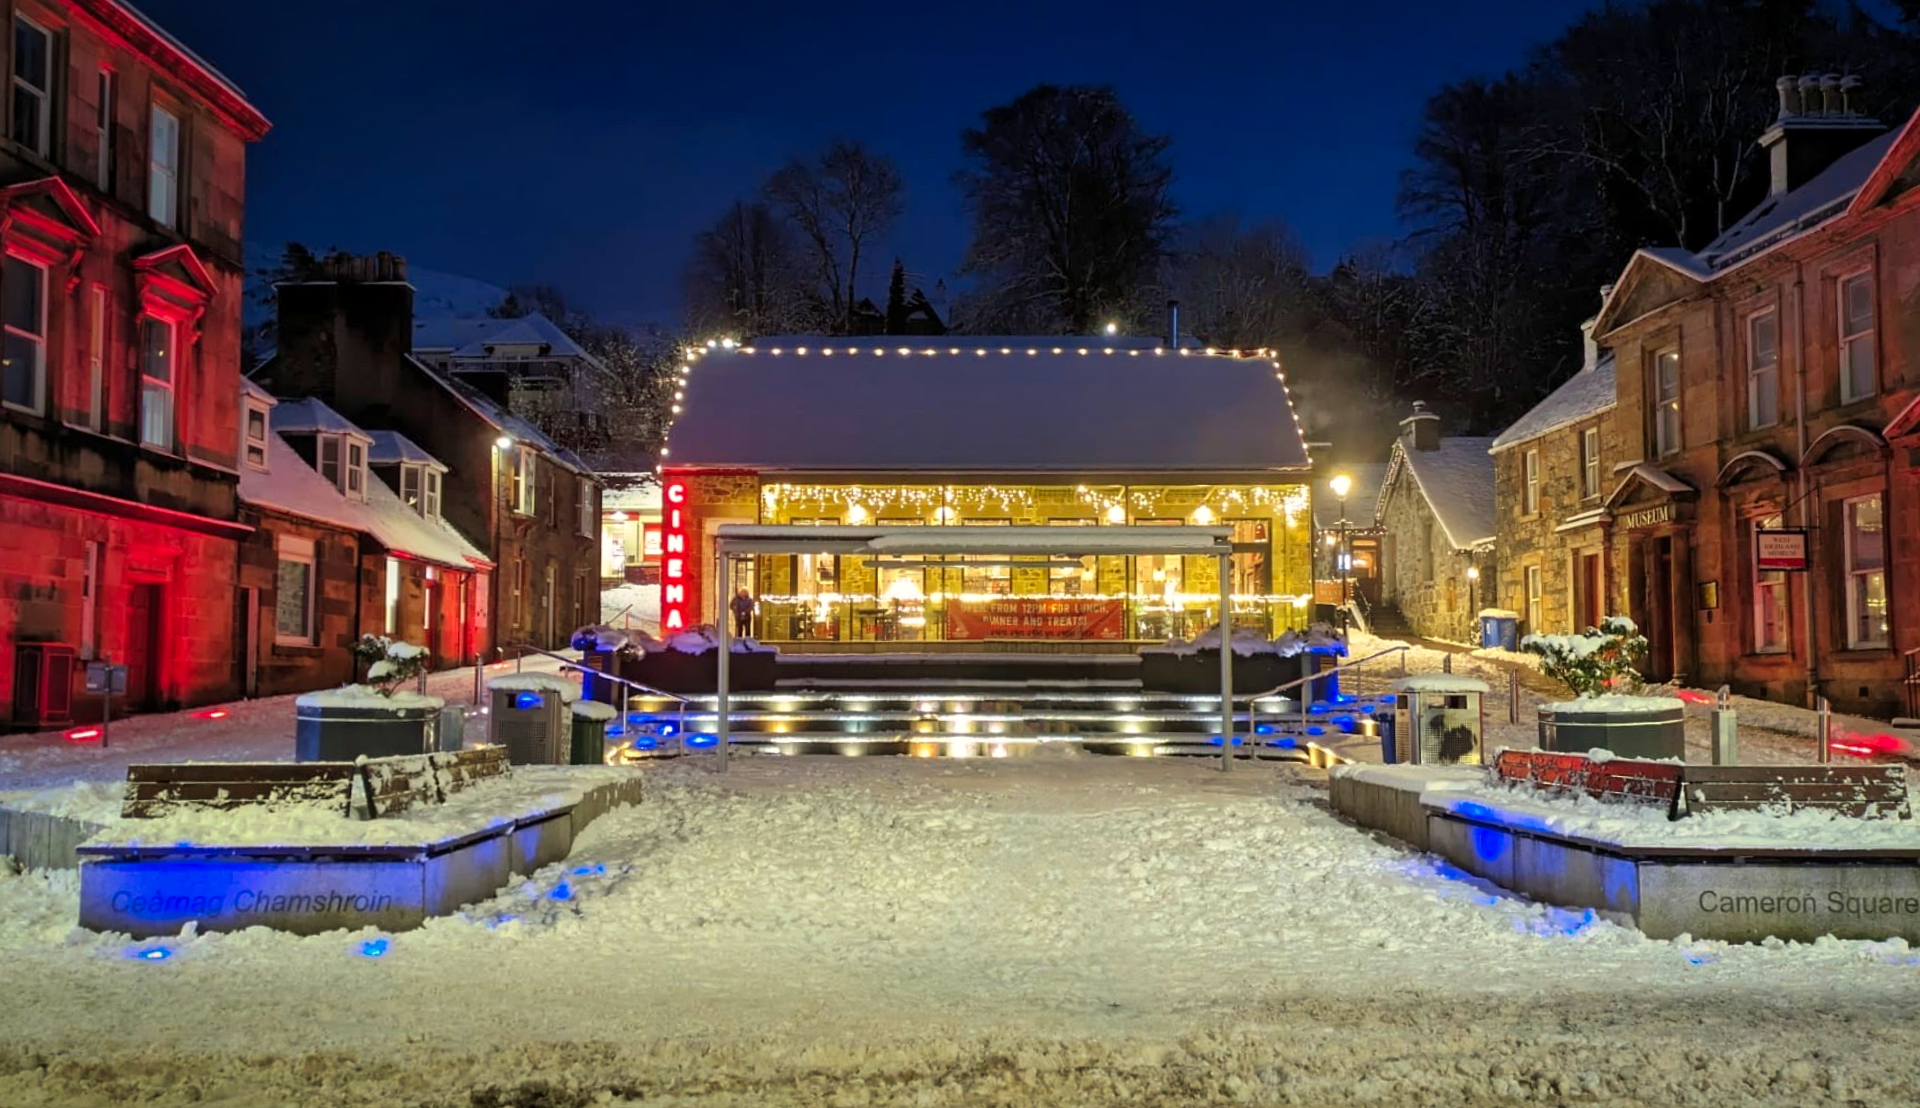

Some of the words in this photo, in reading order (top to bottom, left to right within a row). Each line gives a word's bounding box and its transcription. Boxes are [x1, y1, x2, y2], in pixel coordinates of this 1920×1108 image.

[1626, 505, 1669, 530] MUSEUM
[666, 484, 684, 629] CINEMA
[991, 603, 1018, 614] FROM
[1022, 603, 1047, 614] 12PM
[1051, 603, 1070, 614] FOR
[1023, 615, 1043, 626] AND
[234, 889, 393, 913] Chamshroin
[1700, 890, 1817, 914] Cameron
[1827, 890, 1919, 919] Square
